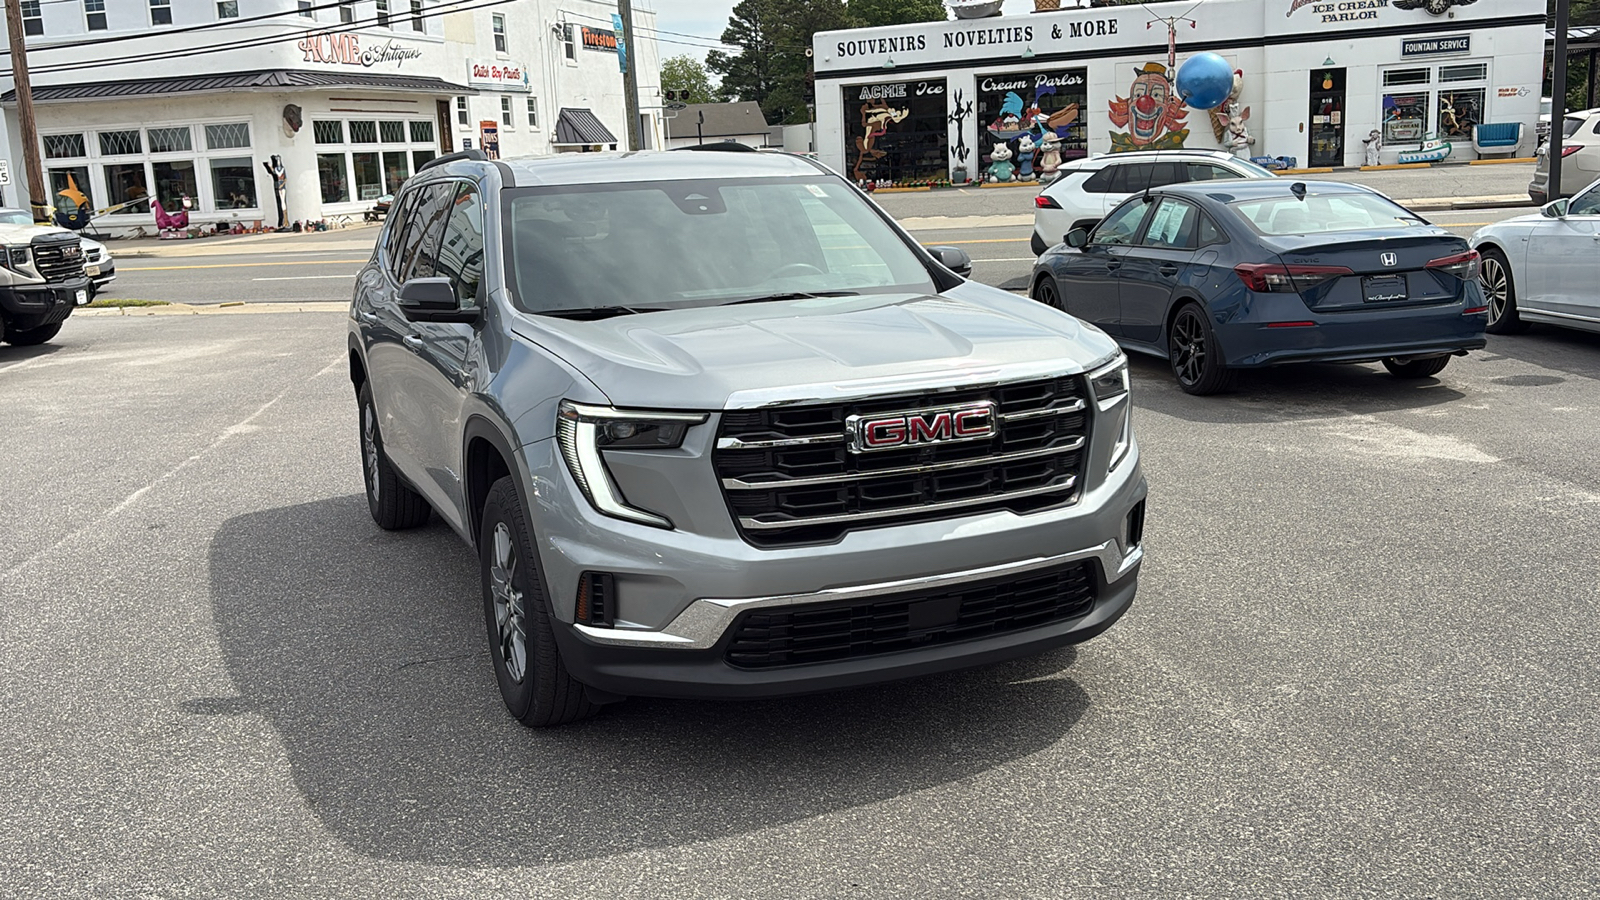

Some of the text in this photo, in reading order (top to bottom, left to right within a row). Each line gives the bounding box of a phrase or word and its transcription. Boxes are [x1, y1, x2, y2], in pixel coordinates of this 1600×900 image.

[1312, 4, 1335, 13] ICE
[1338, 0, 1388, 11] CREAM
[1321, 10, 1378, 23] PARLOR
[582, 27, 617, 47] Fireston
[837, 18, 1118, 57] SOUVENIRS NOVELTIES & MORE
[1404, 39, 1468, 53] FOUNTAIN SERVICE
[298, 31, 422, 68] ACME Antiques
[473, 64, 520, 81] Dutch Boy Paints
[859, 81, 944, 100] ACME Ice
[981, 73, 1084, 91] Cream Parlor
[0, 172, 9, 182] 5
[864, 408, 991, 447] GMC
